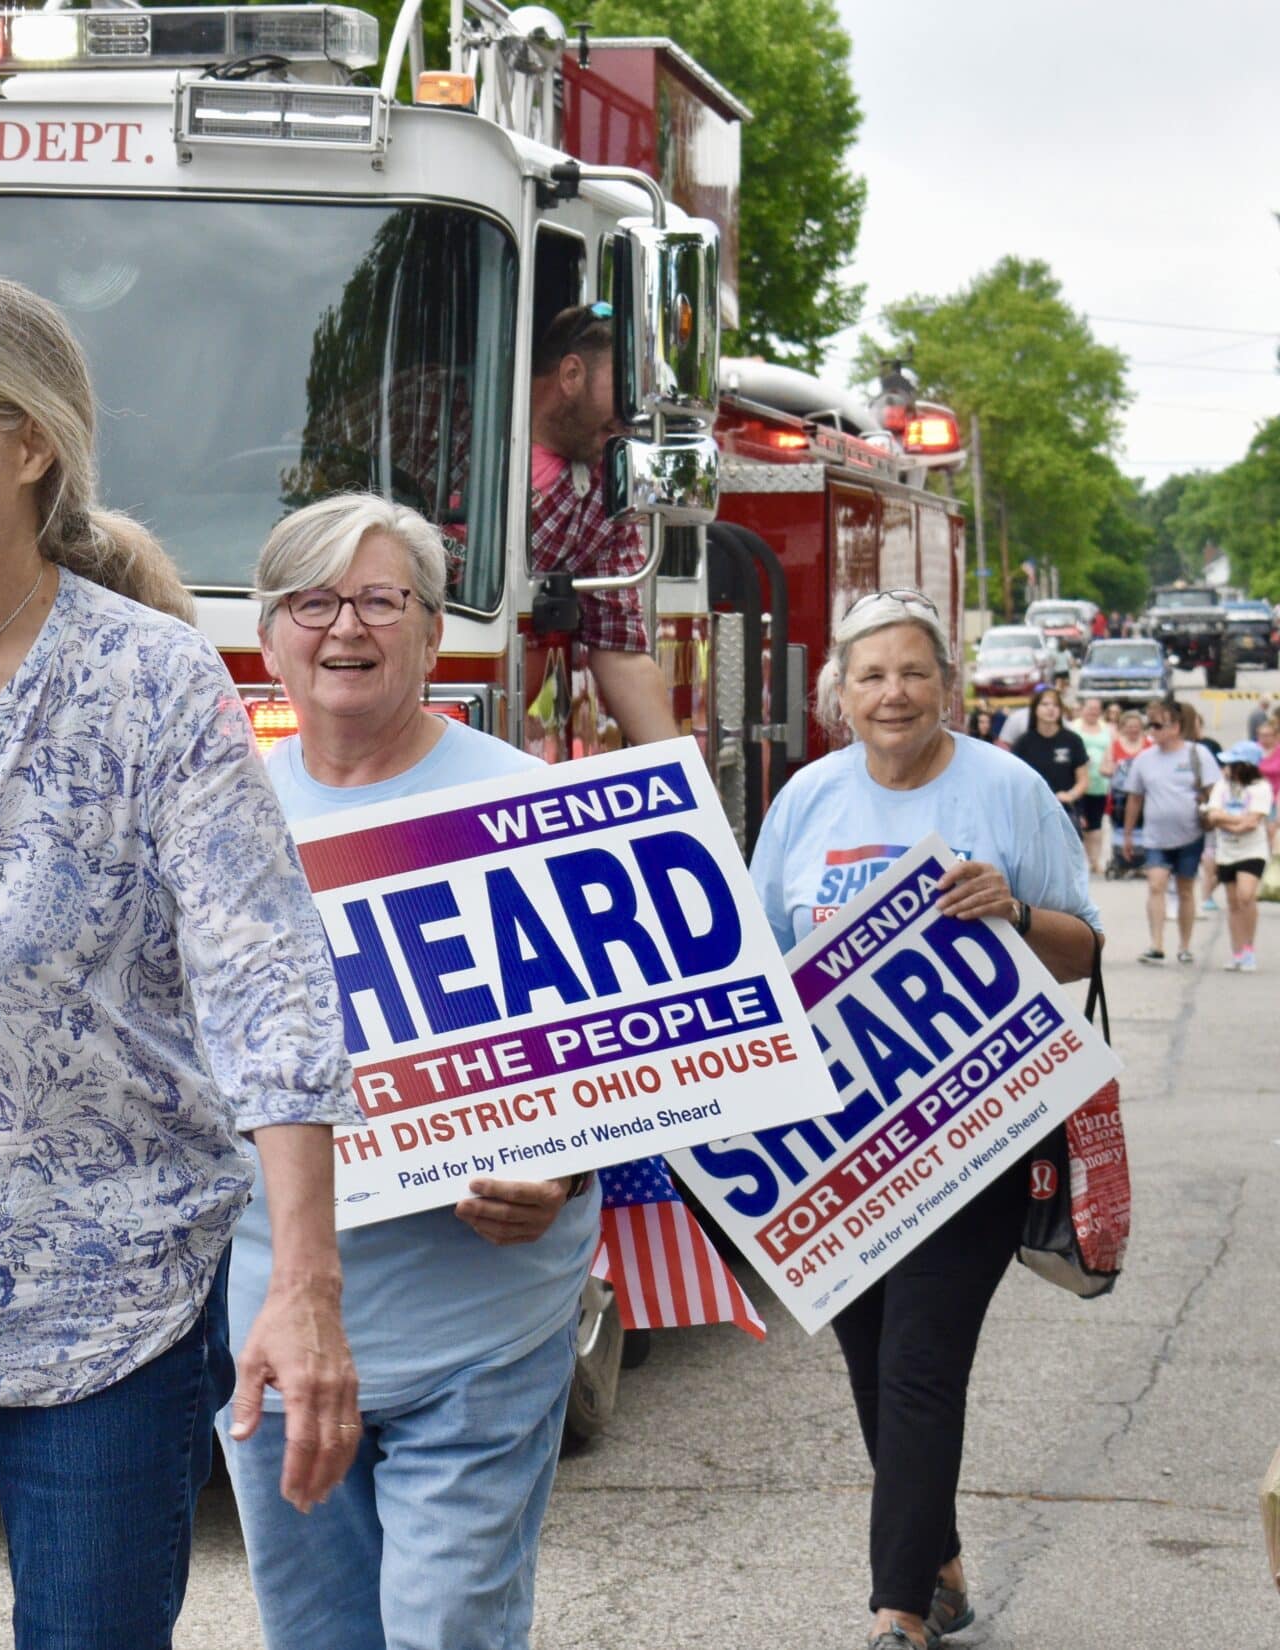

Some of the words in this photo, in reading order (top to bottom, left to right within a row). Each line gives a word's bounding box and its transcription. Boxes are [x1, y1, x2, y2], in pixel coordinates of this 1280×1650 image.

[478, 776, 682, 843] WENDA
[323, 830, 742, 1054] HEARD
[815, 909, 836, 922] FO
[816, 874, 939, 979] WENDA
[335, 1129, 383, 1165] TH
[390, 1087, 558, 1152] DISTRICT
[572, 1065, 661, 1108] OHIO
[671, 1033, 797, 1086] HOUSE
[414, 1040, 532, 1093] THE
[545, 986, 767, 1065] PEOPLE
[398, 1164, 440, 1188] Paid
[443, 1159, 469, 1178] for
[472, 1153, 496, 1173] by
[498, 1136, 567, 1165] Friends
[570, 1129, 588, 1148] of
[590, 1117, 654, 1143] Wenda
[657, 1098, 722, 1128] Sheard
[766, 1185, 843, 1255] FOR
[841, 1119, 917, 1186] THE
[916, 1004, 1053, 1126] PEOPLE
[786, 1233, 845, 1288] 94TH
[842, 1145, 945, 1238] DISTRICT
[946, 1097, 1003, 1150] OHIO
[1003, 1029, 1083, 1102] HOUSE
[858, 1236, 887, 1265] Paid
[884, 1224, 903, 1246] for
[901, 1211, 920, 1231] by
[915, 1181, 959, 1217] Friends
[958, 1164, 973, 1183] of
[968, 1135, 1009, 1171] Wenda
[1007, 1100, 1049, 1140] Sheard
